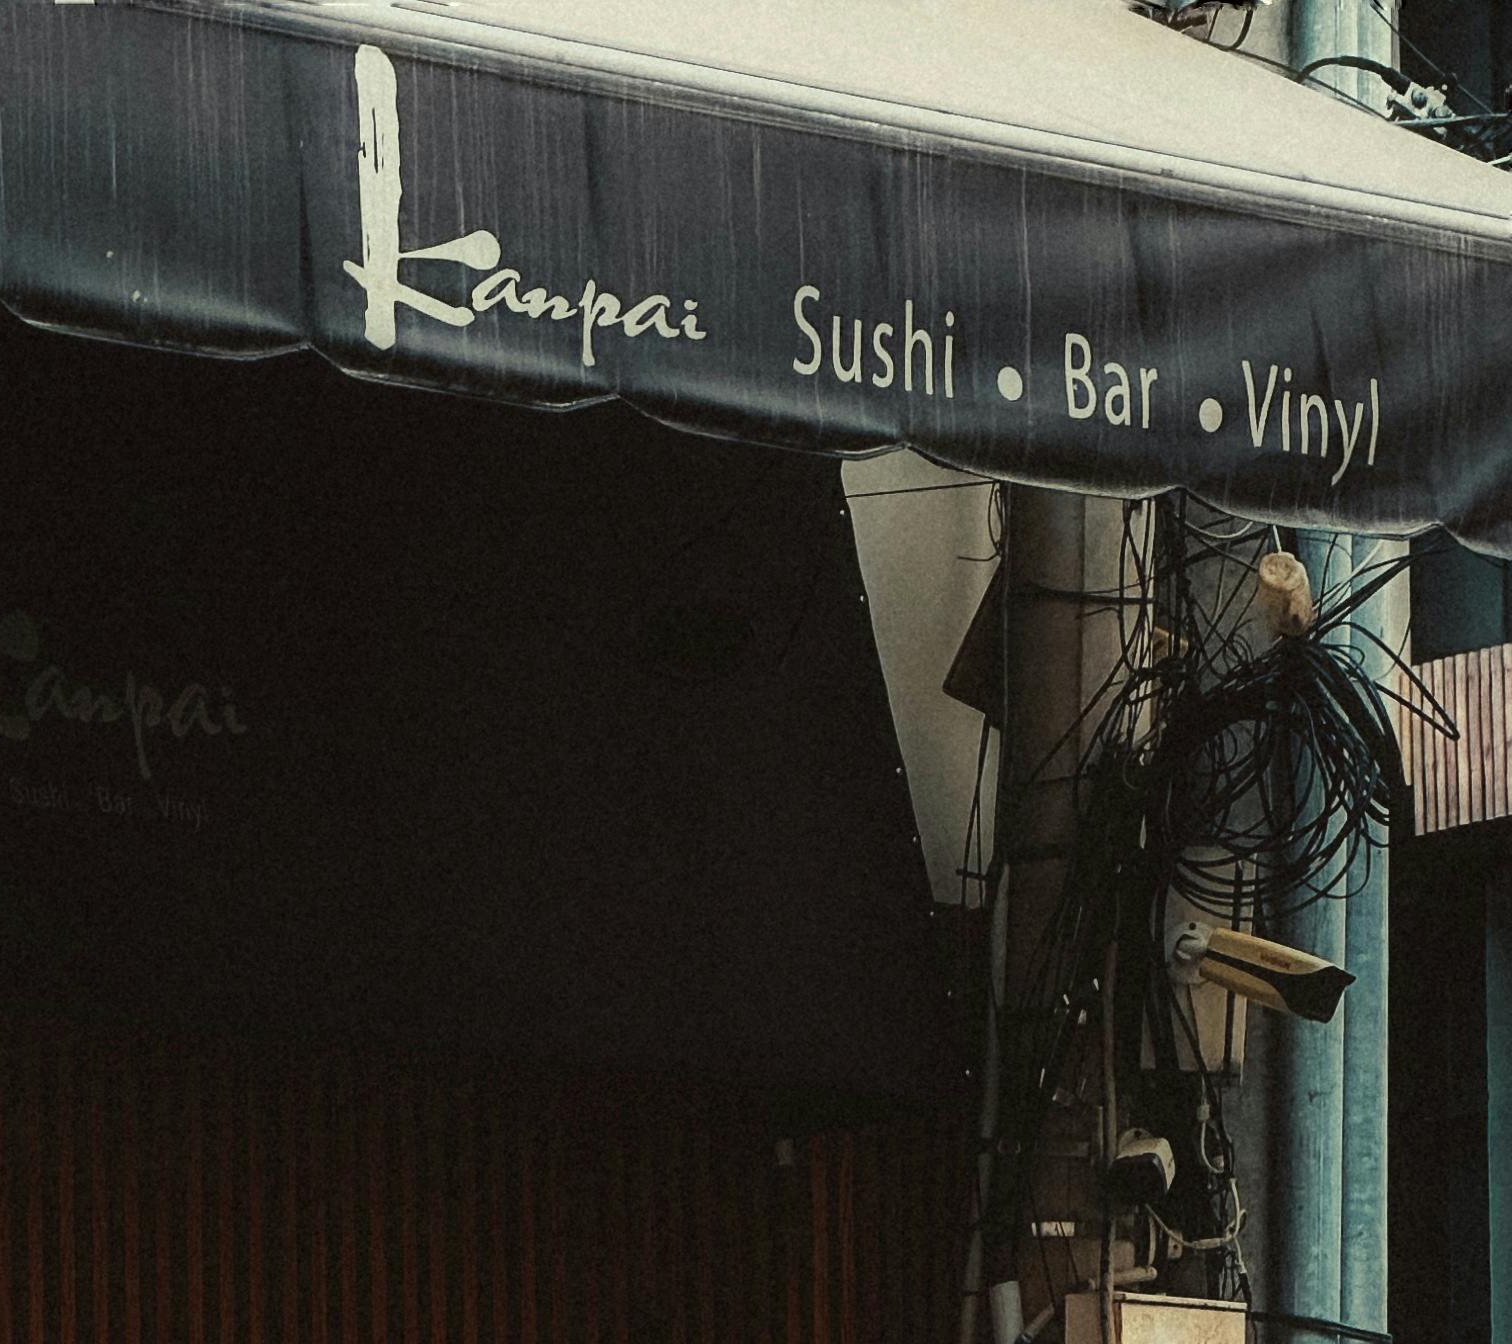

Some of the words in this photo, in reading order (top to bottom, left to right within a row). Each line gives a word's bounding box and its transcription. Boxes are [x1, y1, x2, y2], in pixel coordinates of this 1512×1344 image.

[343, 44, 707, 367] Kanpai
[793, 285, 955, 399] Sushi
[1064, 333, 1158, 429] Bar
[1241, 360, 1380, 485] Vinyl
